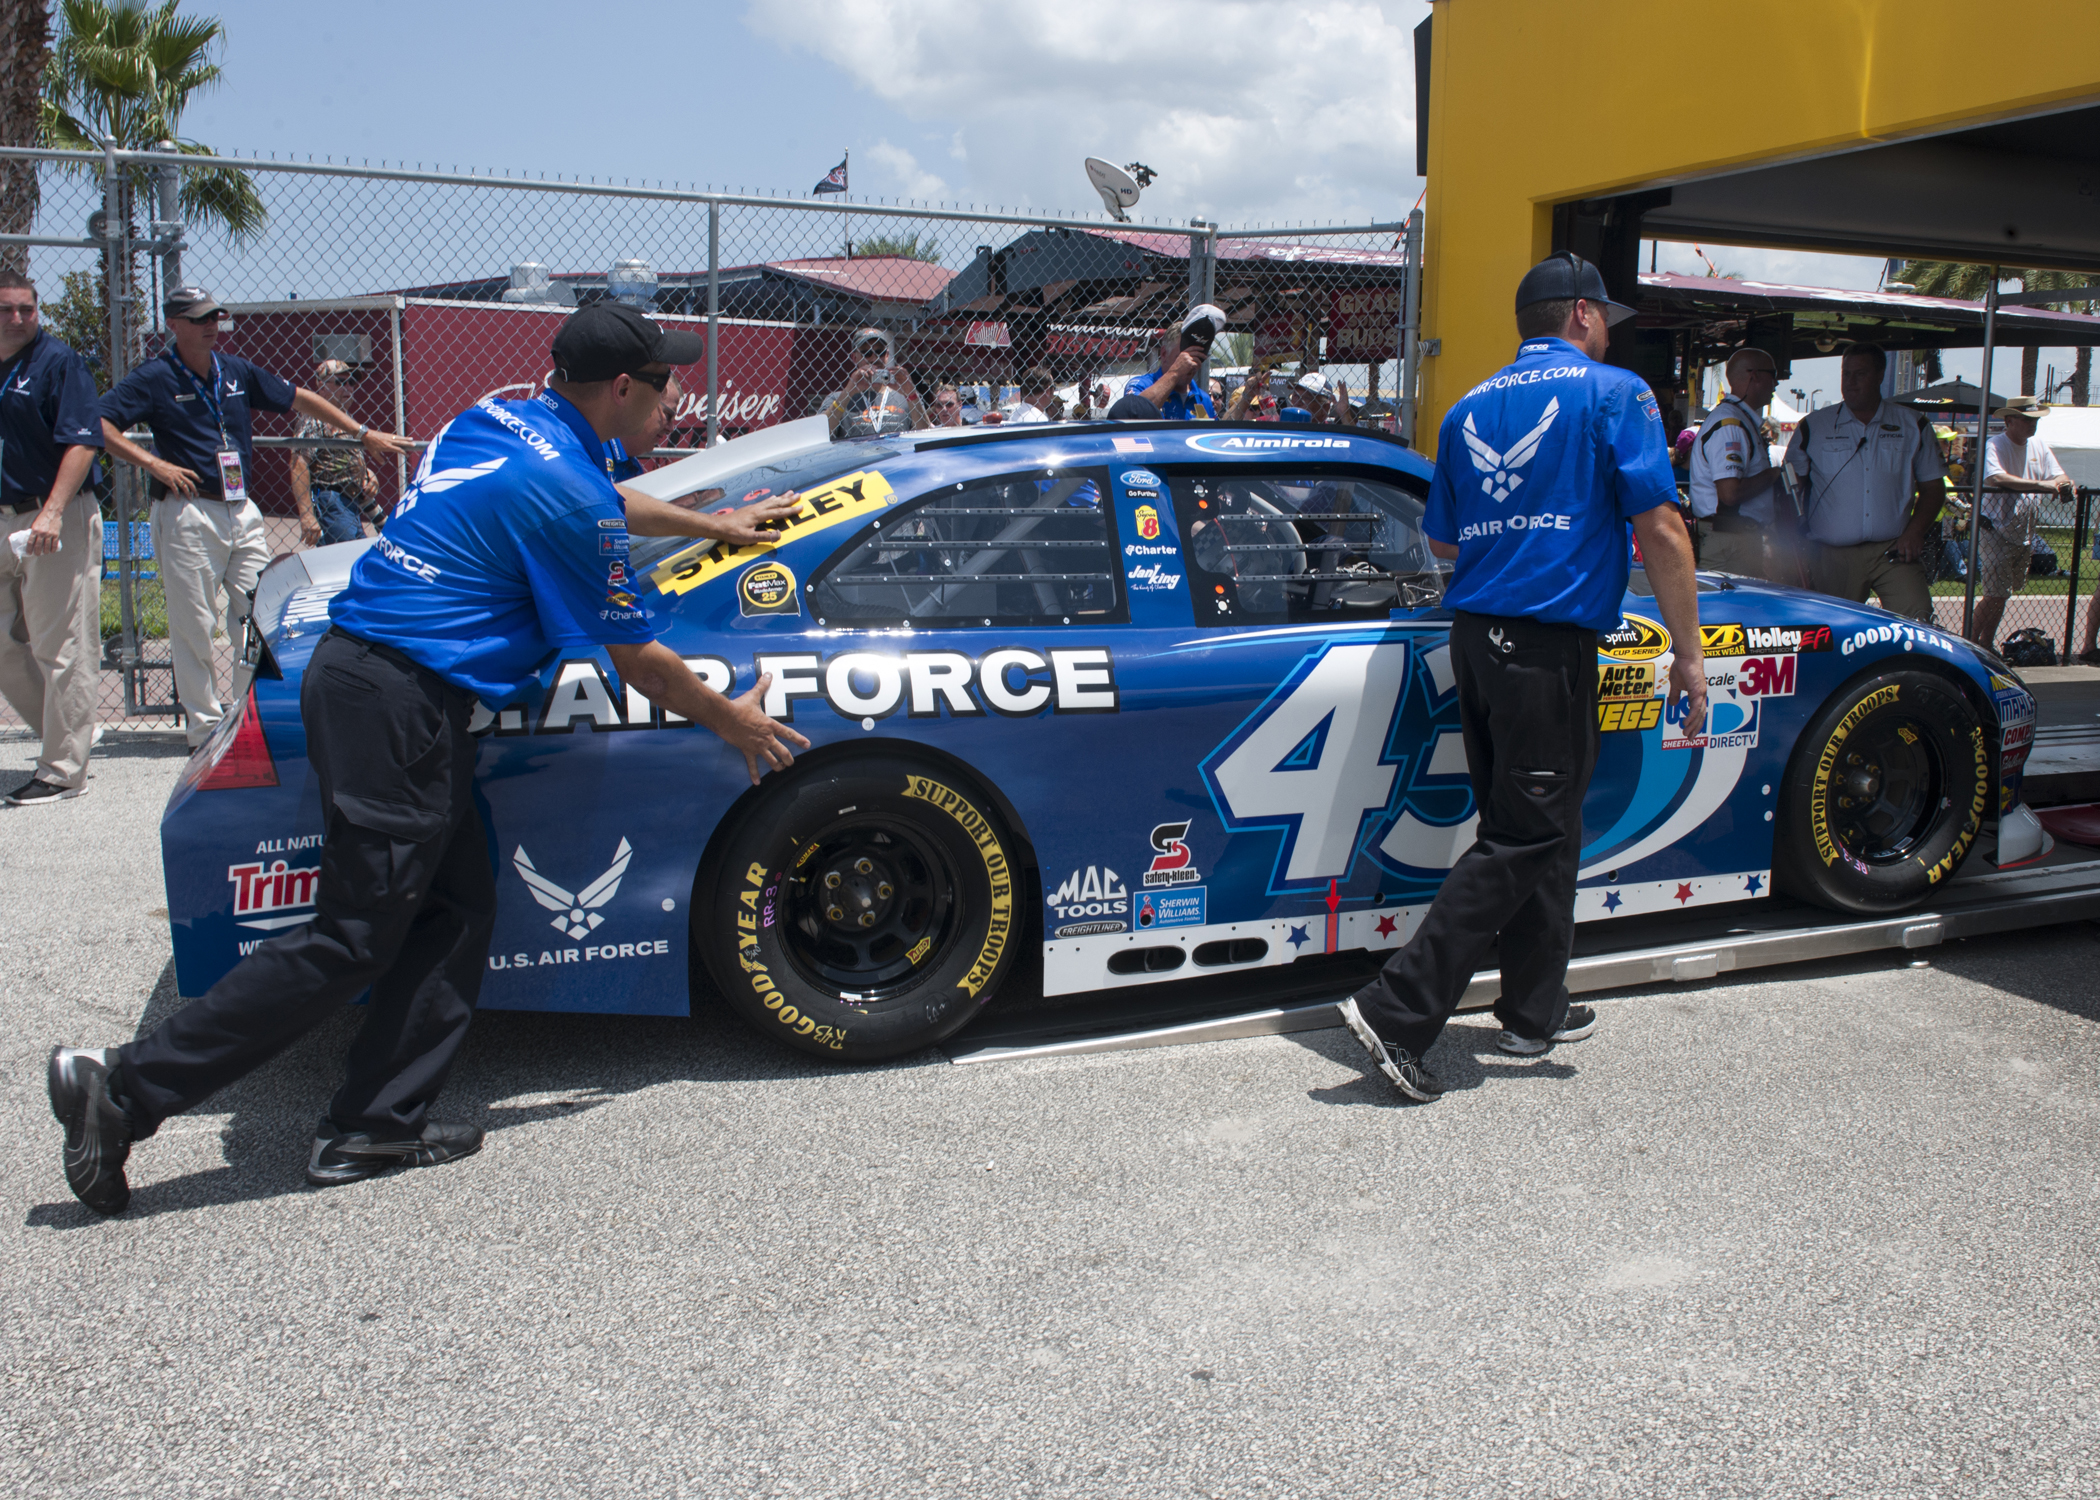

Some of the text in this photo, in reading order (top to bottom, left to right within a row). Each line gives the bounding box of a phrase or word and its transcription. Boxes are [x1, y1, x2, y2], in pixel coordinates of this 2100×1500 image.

[1120, 187, 1133, 195] HD
[1338, 293, 1401, 315] GRAB
[1351, 314, 1391, 328] SOME
[1337, 328, 1399, 348] BUDS
[1464, 366, 1588, 400] AIRFORCE.COM
[1220, 436, 1351, 450] Almirola
[1128, 472, 1154, 485] Ford
[1137, 490, 1157, 498] Further
[1142, 518, 1158, 537] 8
[1471, 520, 1503, 537] AIR
[1135, 545, 1177, 555] Charter
[748, 580, 786, 590] FatMax
[761, 591, 778, 602] 25
[1604, 629, 1638, 646] Sprint
[1746, 626, 1832, 652] Holley EFI
[1841, 622, 1954, 656] GOODYEAR
[1613, 647, 1661, 656] CUP SERIES
[1721, 645, 1746, 656] WEAR
[1603, 665, 1646, 682] Auto
[1738, 655, 1796, 697] 3M
[759, 648, 1118, 720] FORCE
[1598, 679, 1654, 697] Meter
[1665, 696, 1709, 735] US
[1662, 739, 1706, 749] SHEETROCK
[1709, 734, 1757, 749] DIRECTV
[1206, 639, 1482, 886] 43
[1812, 686, 1896, 860] SUPPORT OUR TROOPS
[1927, 750, 1989, 884] GOODYEAR
[255, 834, 327, 855] ALL NATU
[228, 859, 322, 916] Trim
[912, 777, 1012, 990] SUPPORT OUR TROOPS
[1055, 864, 1128, 904] MAC
[1054, 900, 1128, 919] TOOLS
[1159, 896, 1200, 909] SHERWIN
[1158, 906, 1200, 919] WILLIAMS
[1158, 915, 1201, 925] Automotive Finishes
[1061, 922, 1121, 936] FREIGHTLINER
[489, 940, 669, 970] U.S. AIR FORCE
[737, 860, 816, 1036] GOODYEAR
